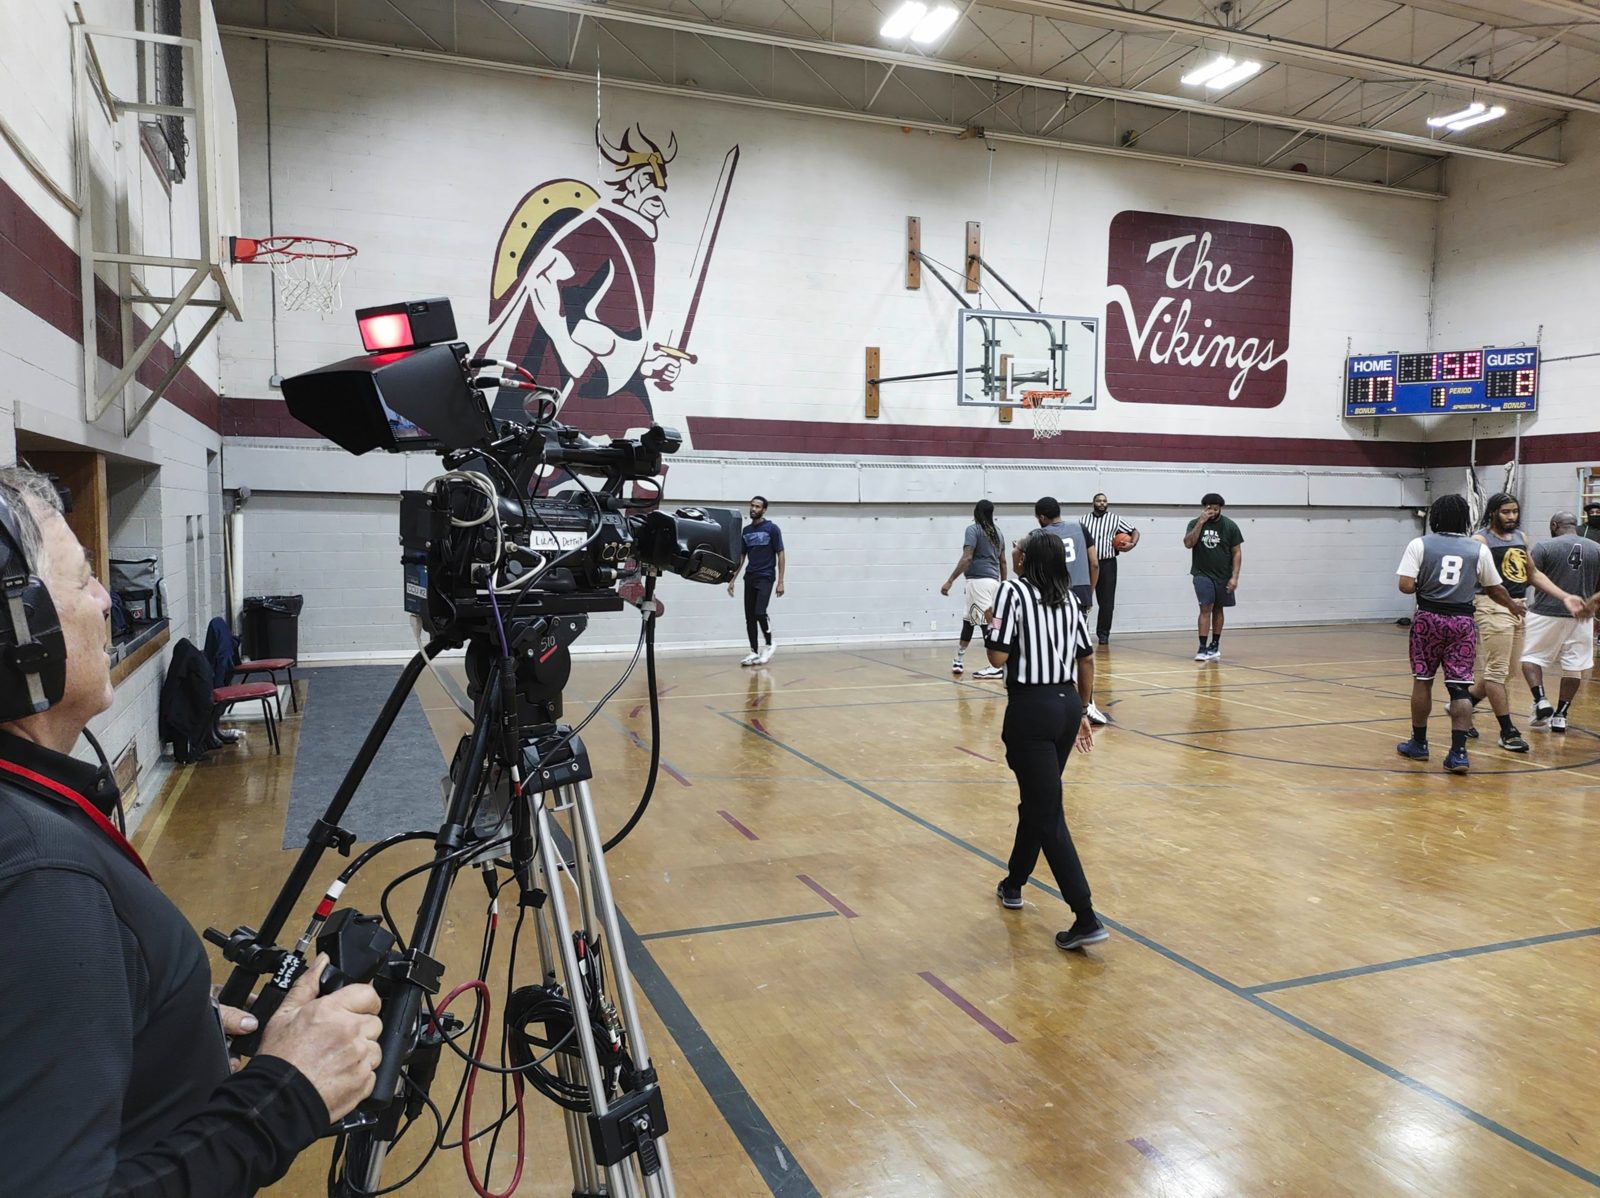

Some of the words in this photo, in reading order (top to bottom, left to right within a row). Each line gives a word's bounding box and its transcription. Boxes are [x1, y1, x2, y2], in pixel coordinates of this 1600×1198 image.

[1145, 231, 1255, 293] The
[1106, 283, 1288, 401] Vikings
[1353, 359, 1392, 373] HOME
[1431, 351, 1481, 379] 1:58
[1486, 352, 1535, 366] GUEST
[1368, 376, 1393, 403] 17
[1448, 386, 1473, 395] PERIOD
[1515, 369, 1535, 397] 8
[1354, 407, 1377, 415] BONUS
[1502, 401, 1527, 409] BONUS
[1438, 554, 1464, 586] 8
[1567, 543, 1583, 571] 4
[277, 957, 301, 989] Detroit
